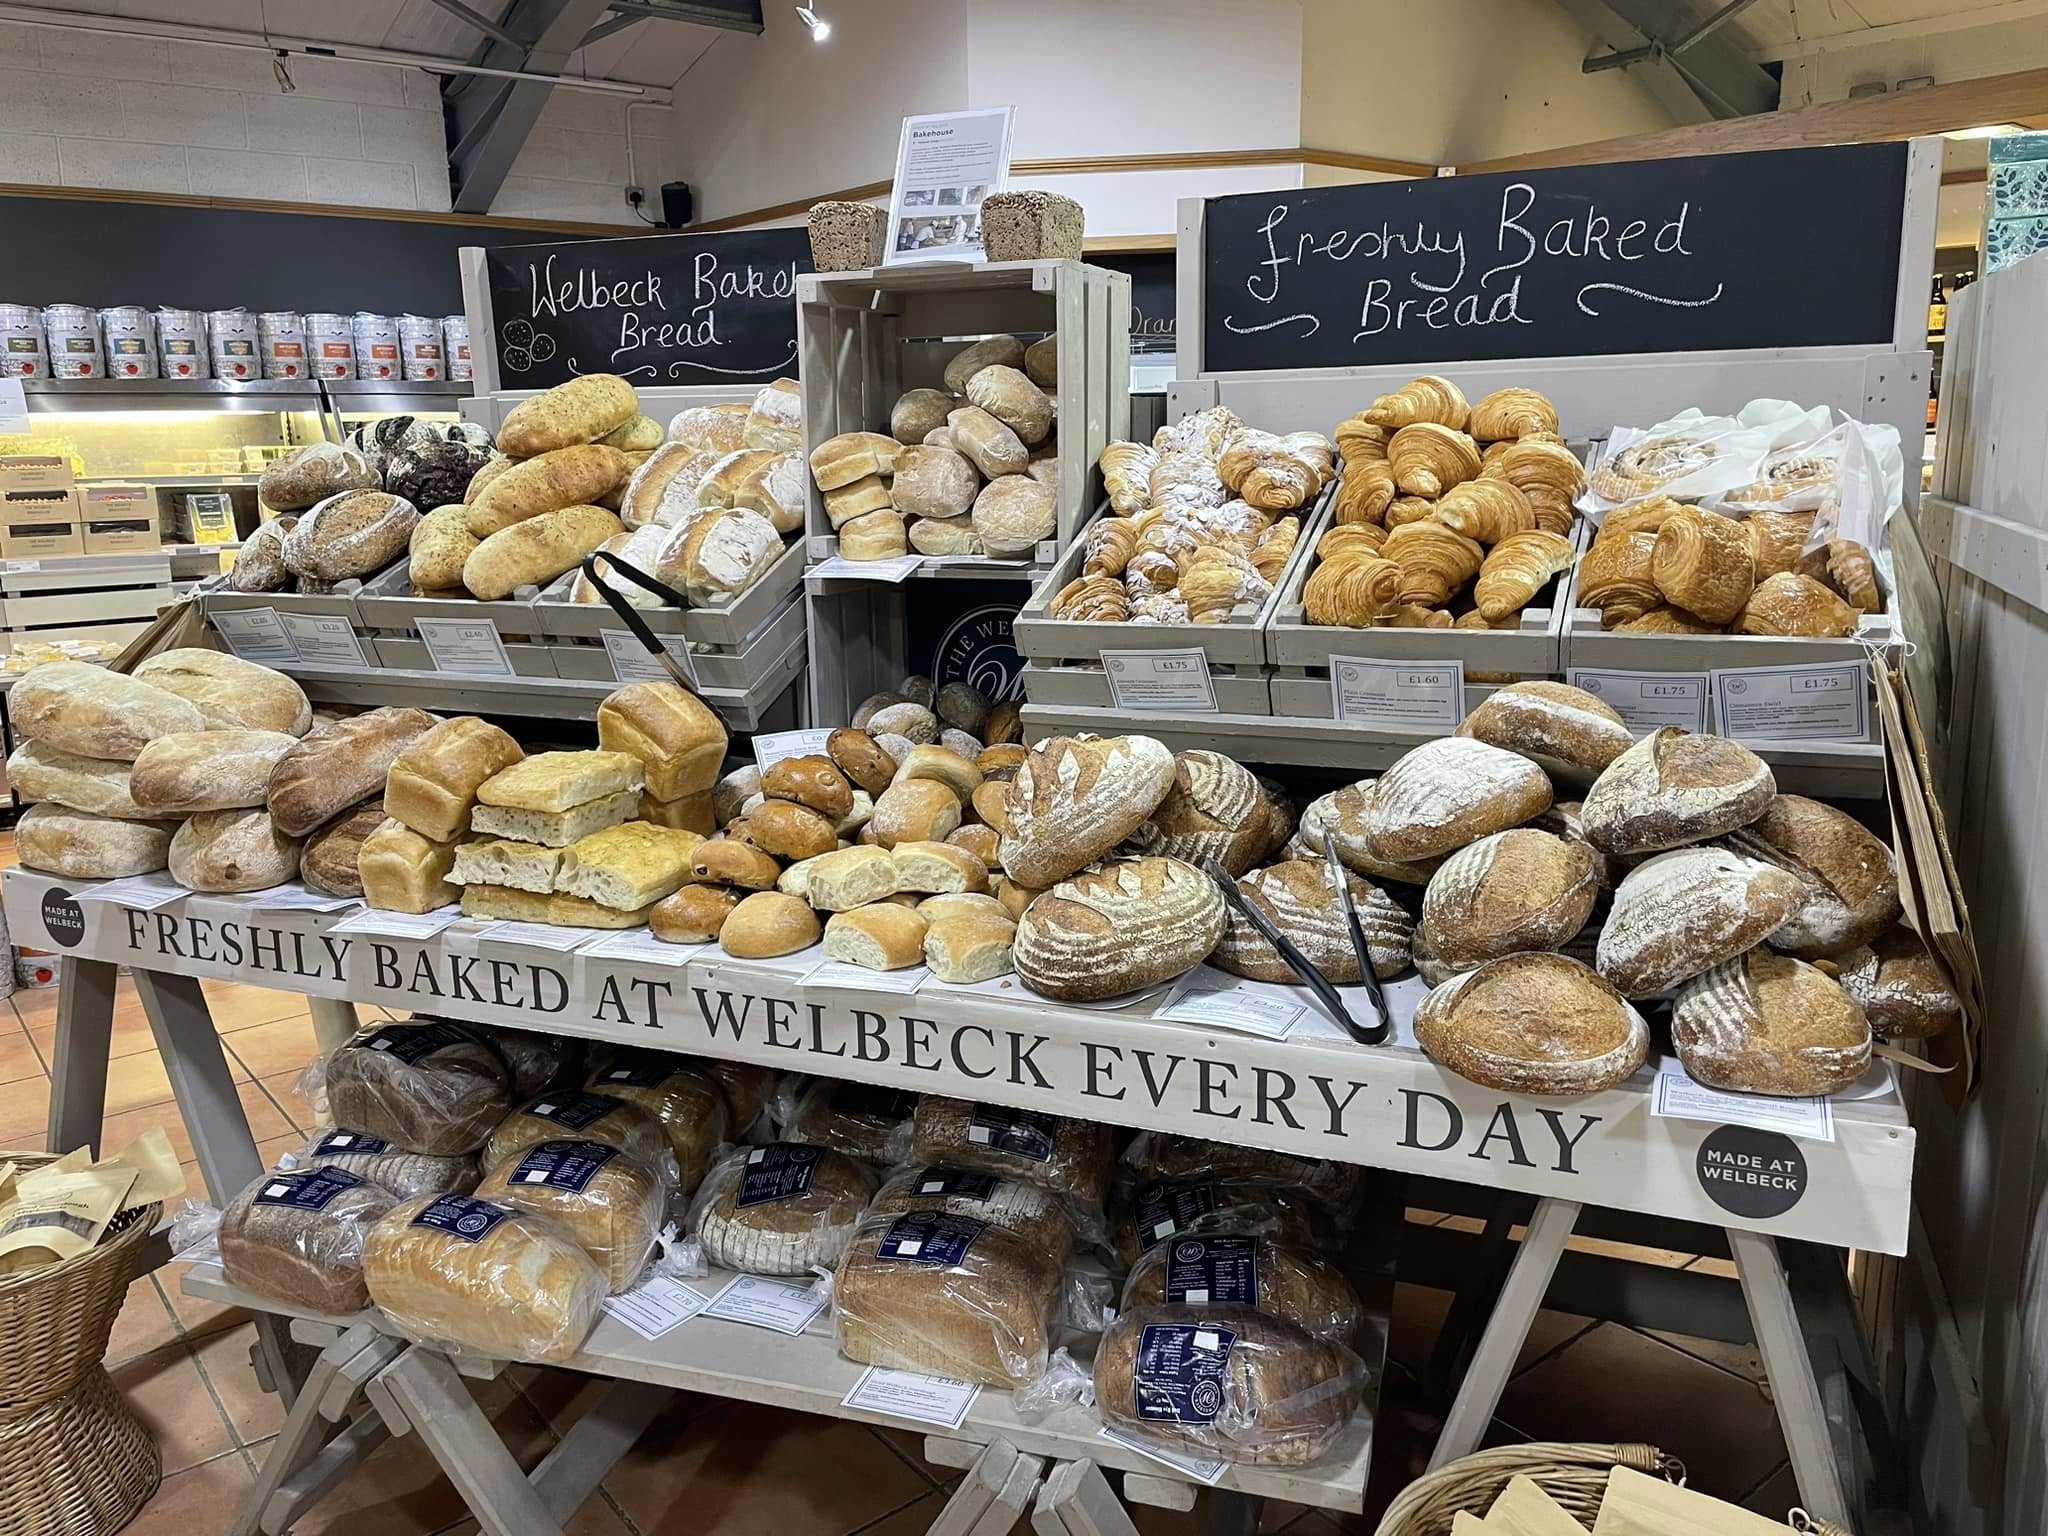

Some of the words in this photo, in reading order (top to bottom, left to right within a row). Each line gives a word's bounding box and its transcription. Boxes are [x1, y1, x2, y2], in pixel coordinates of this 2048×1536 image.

[912, 128, 954, 138] Bakehouse
[1481, 183, 1693, 289] Baked
[529, 254, 666, 319] Welbeck
[1352, 274, 1534, 344] Bread
[946, 635, 976, 679] THE
[1163, 661, 1188, 669] £1.75
[1409, 674, 1439, 684] £1.60
[1804, 678, 1838, 688] £1.75
[1654, 686, 1686, 695] £1.75
[45, 906, 67, 916] MADE
[69, 910, 79, 918] AT
[45, 917, 82, 929] WELBECK
[124, 907, 353, 982] FRESHLY
[370, 943, 570, 1013] BAKED
[592, 974, 673, 1029] AT
[692, 986, 1055, 1090] WELBECK
[1080, 1041, 1368, 1137] EVERY
[1397, 1087, 1602, 1174] DAY
[1707, 1150, 1763, 1168] MADE
[1769, 1159, 1796, 1173] AT
[1703, 1166, 1798, 1191] WELBECK
